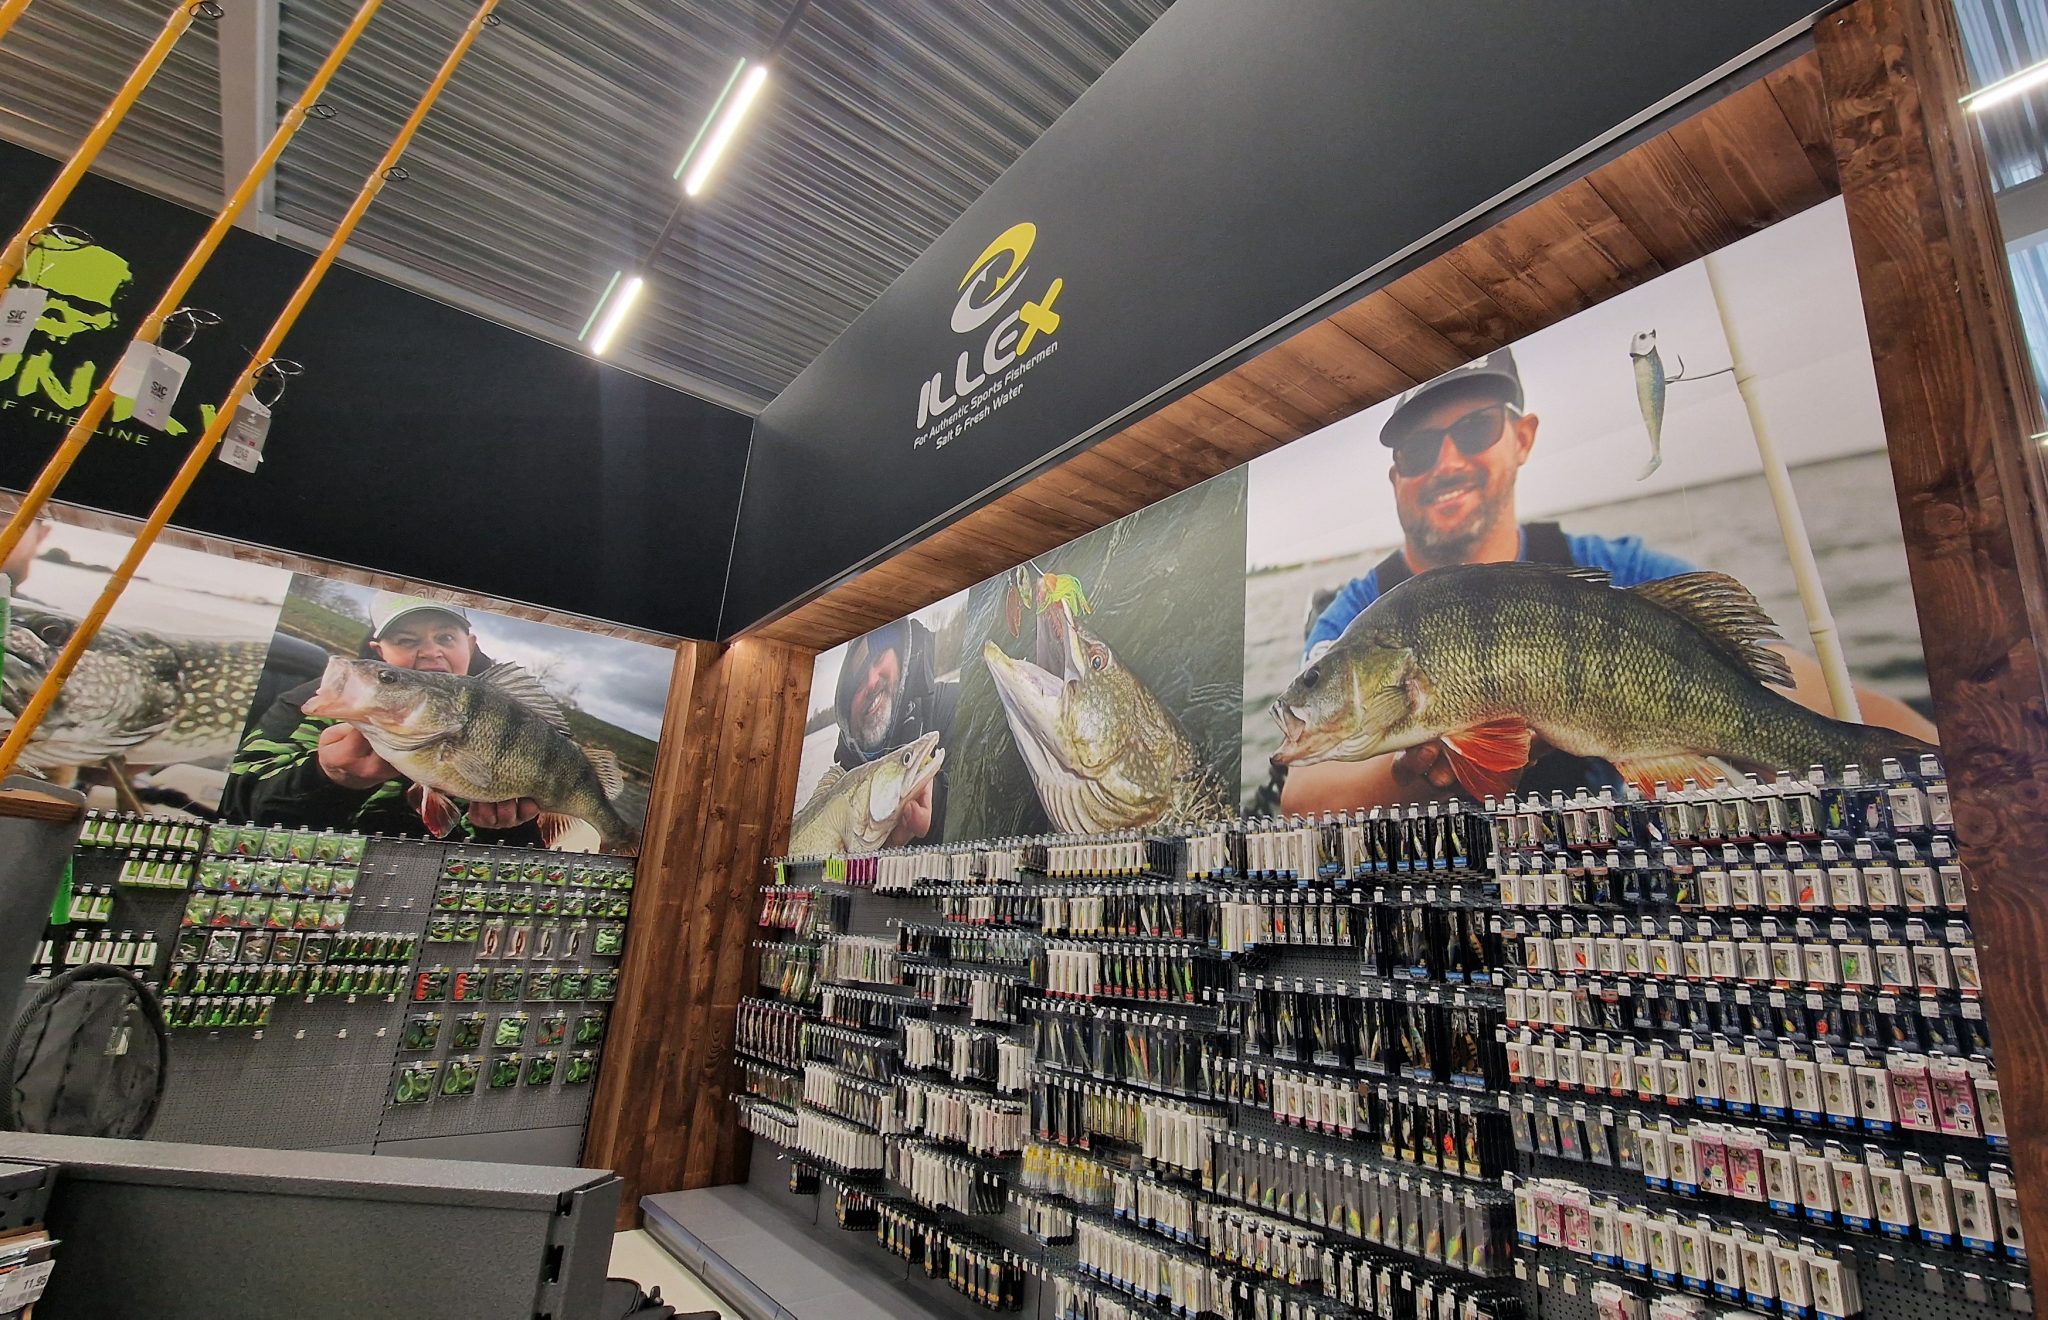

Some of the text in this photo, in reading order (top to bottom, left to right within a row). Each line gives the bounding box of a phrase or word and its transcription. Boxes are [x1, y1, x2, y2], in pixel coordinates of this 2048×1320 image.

[913, 341, 1058, 450] For Authentic Sports Fishermen
[917, 278, 1062, 429] ILLEX
[936, 383, 1024, 450] Salt & Fresh Water
